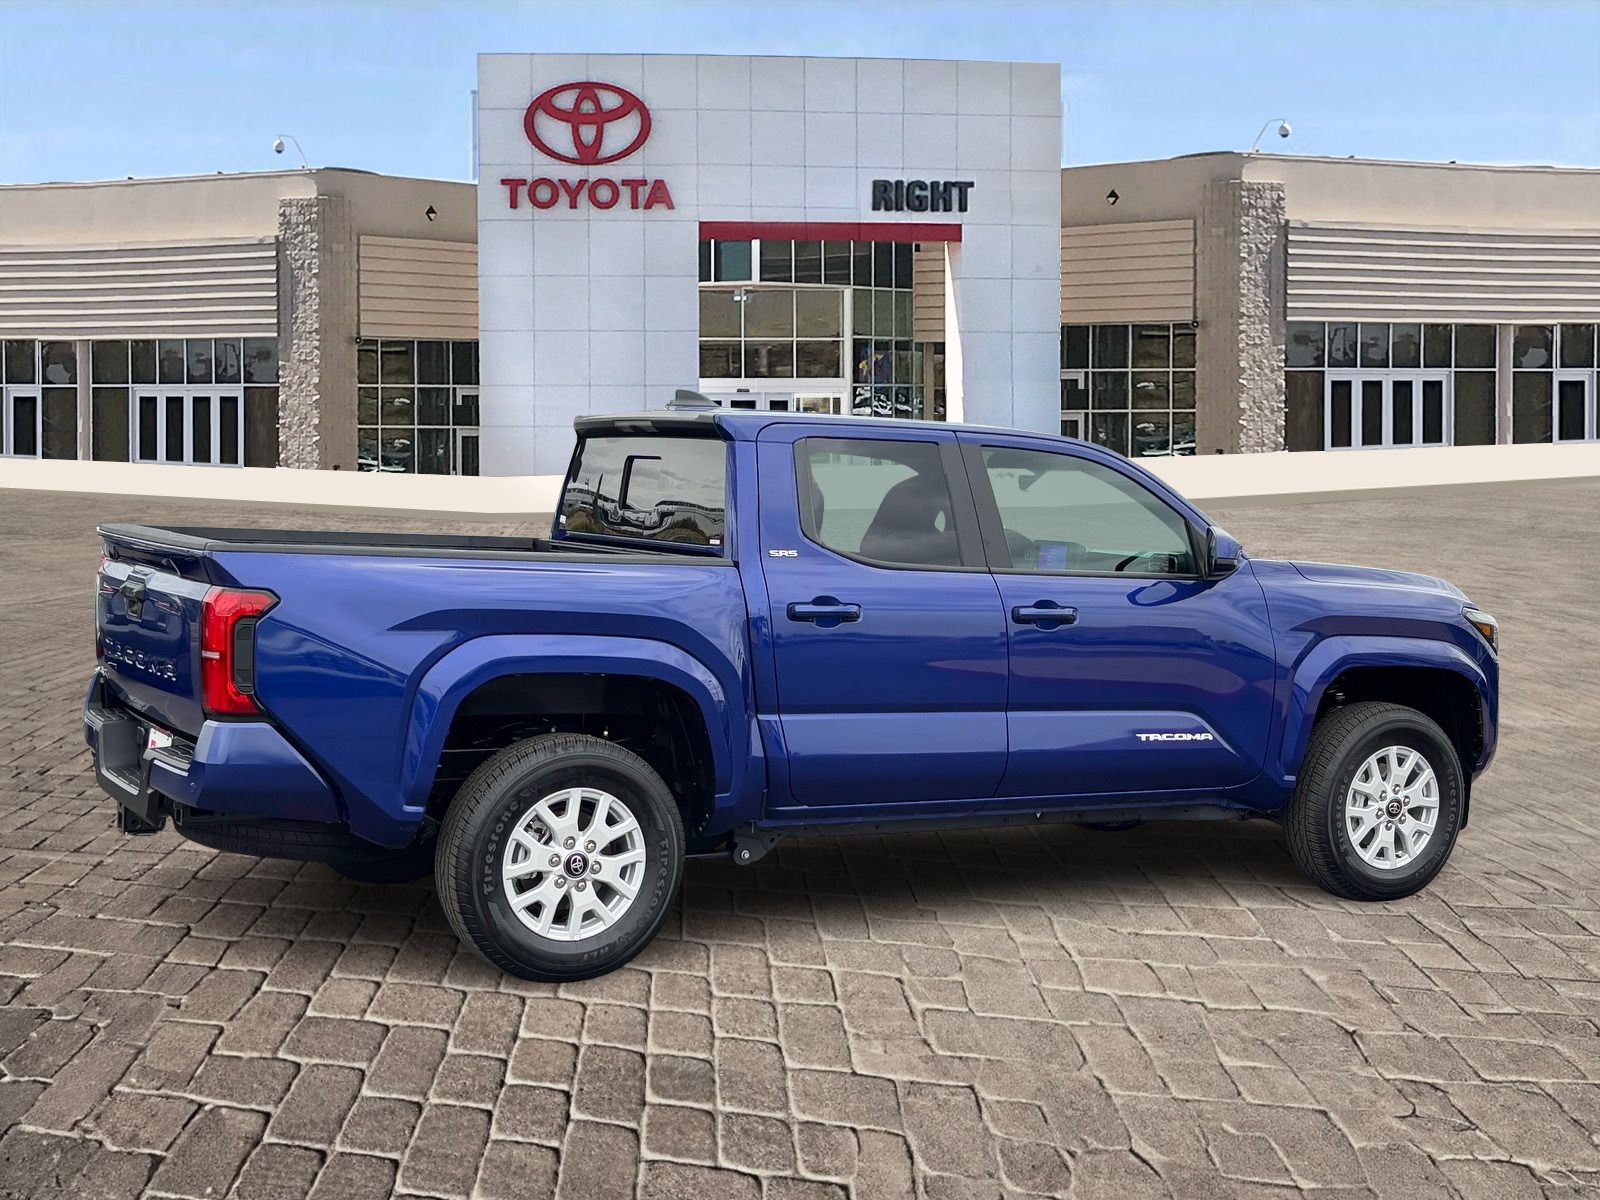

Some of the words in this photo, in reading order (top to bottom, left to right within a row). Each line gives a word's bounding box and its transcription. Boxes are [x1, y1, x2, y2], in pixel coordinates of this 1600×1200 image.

[500, 179, 675, 210] TOYOTA
[871, 179, 974, 213] RIGHT
[1136, 733, 1213, 741] TACOMA
[483, 800, 520, 896] Firestone
